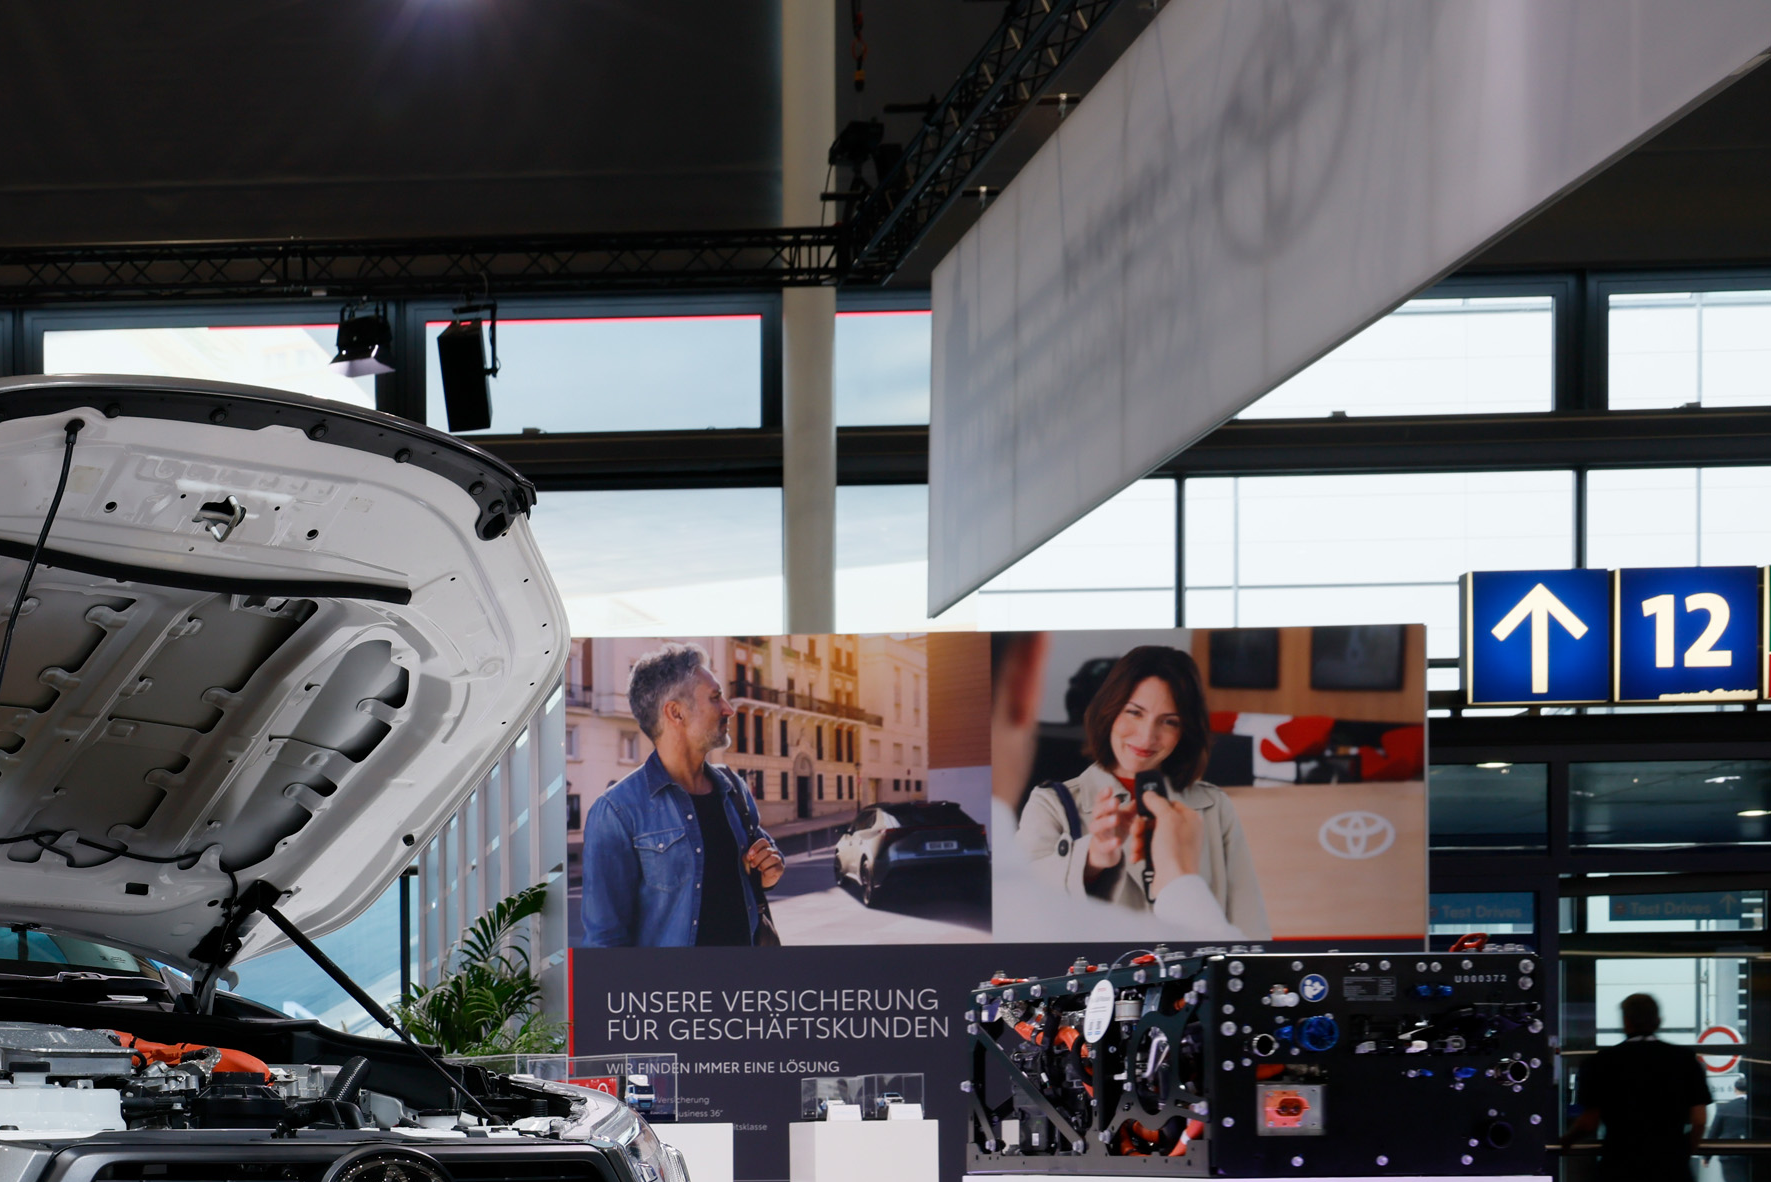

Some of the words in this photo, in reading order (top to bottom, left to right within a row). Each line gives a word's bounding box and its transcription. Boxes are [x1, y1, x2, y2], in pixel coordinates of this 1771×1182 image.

[1641, 592, 1732, 668] 12
[1443, 904, 1473, 919] Test
[1477, 903, 1522, 918] Drives
[1632, 902, 1664, 917] Test
[1669, 901, 1711, 916] Drives
[1454, 974, 1507, 984] U000372
[607, 990, 713, 1014] UNSERE
[722, 988, 939, 1013] VERSICHERUNG
[607, 1015, 659, 1041] FÜR
[668, 1013, 949, 1041] GESCHÄFTSKUNDEN
[606, 1063, 633, 1075] WIR
[638, 1062, 690, 1075] FINDEN
[694, 1061, 740, 1074] IMMER
[744, 1061, 775, 1074] EINE
[780, 1059, 840, 1074] LÖSUNG
